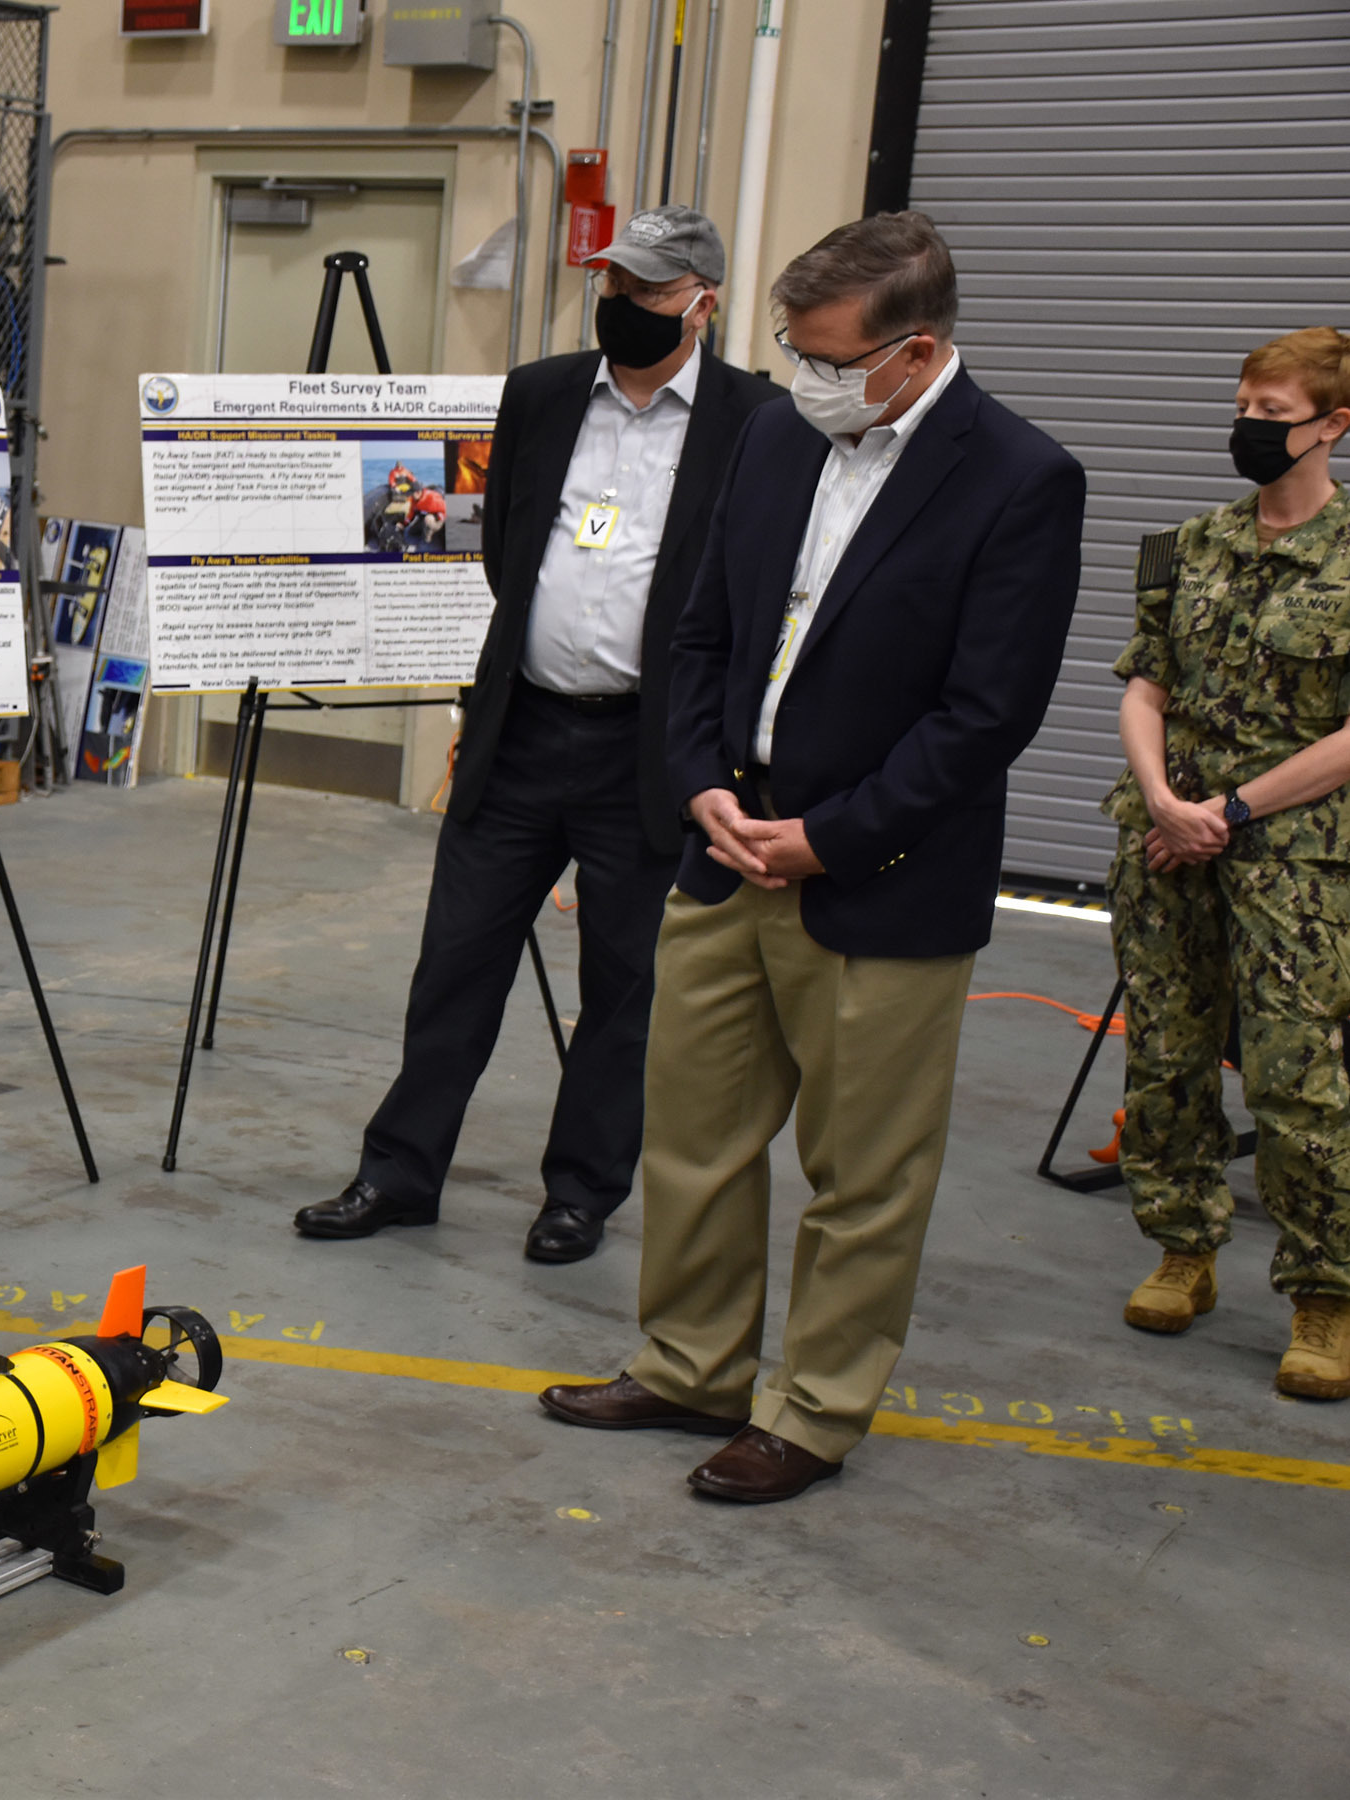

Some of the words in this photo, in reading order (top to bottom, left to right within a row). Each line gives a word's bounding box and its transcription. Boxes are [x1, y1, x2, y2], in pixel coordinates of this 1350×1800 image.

[289, 0, 343, 35] EXIT
[289, 381, 325, 395] Fleet
[331, 381, 382, 397] Survey
[388, 382, 427, 395] Team
[213, 401, 275, 415] Emergent
[280, 401, 367, 415] Requirements
[371, 402, 379, 413] &
[384, 401, 424, 414] HA/DR
[428, 402, 498, 416] Capabilities
[210, 431, 246, 441] Support
[248, 431, 282, 440] Mission
[284, 431, 302, 440] and
[303, 431, 337, 441] Tasking
[591, 519, 606, 535] V
[191, 556, 205, 566] Fly
[207, 556, 231, 566] Away
[233, 555, 257, 564] Team
[258, 555, 310, 565] Capabilities
[423, 553, 464, 563] Emergent
[1307, 600, 1342, 613] NAVY
[225, 678, 281, 687] Oceanraphy
